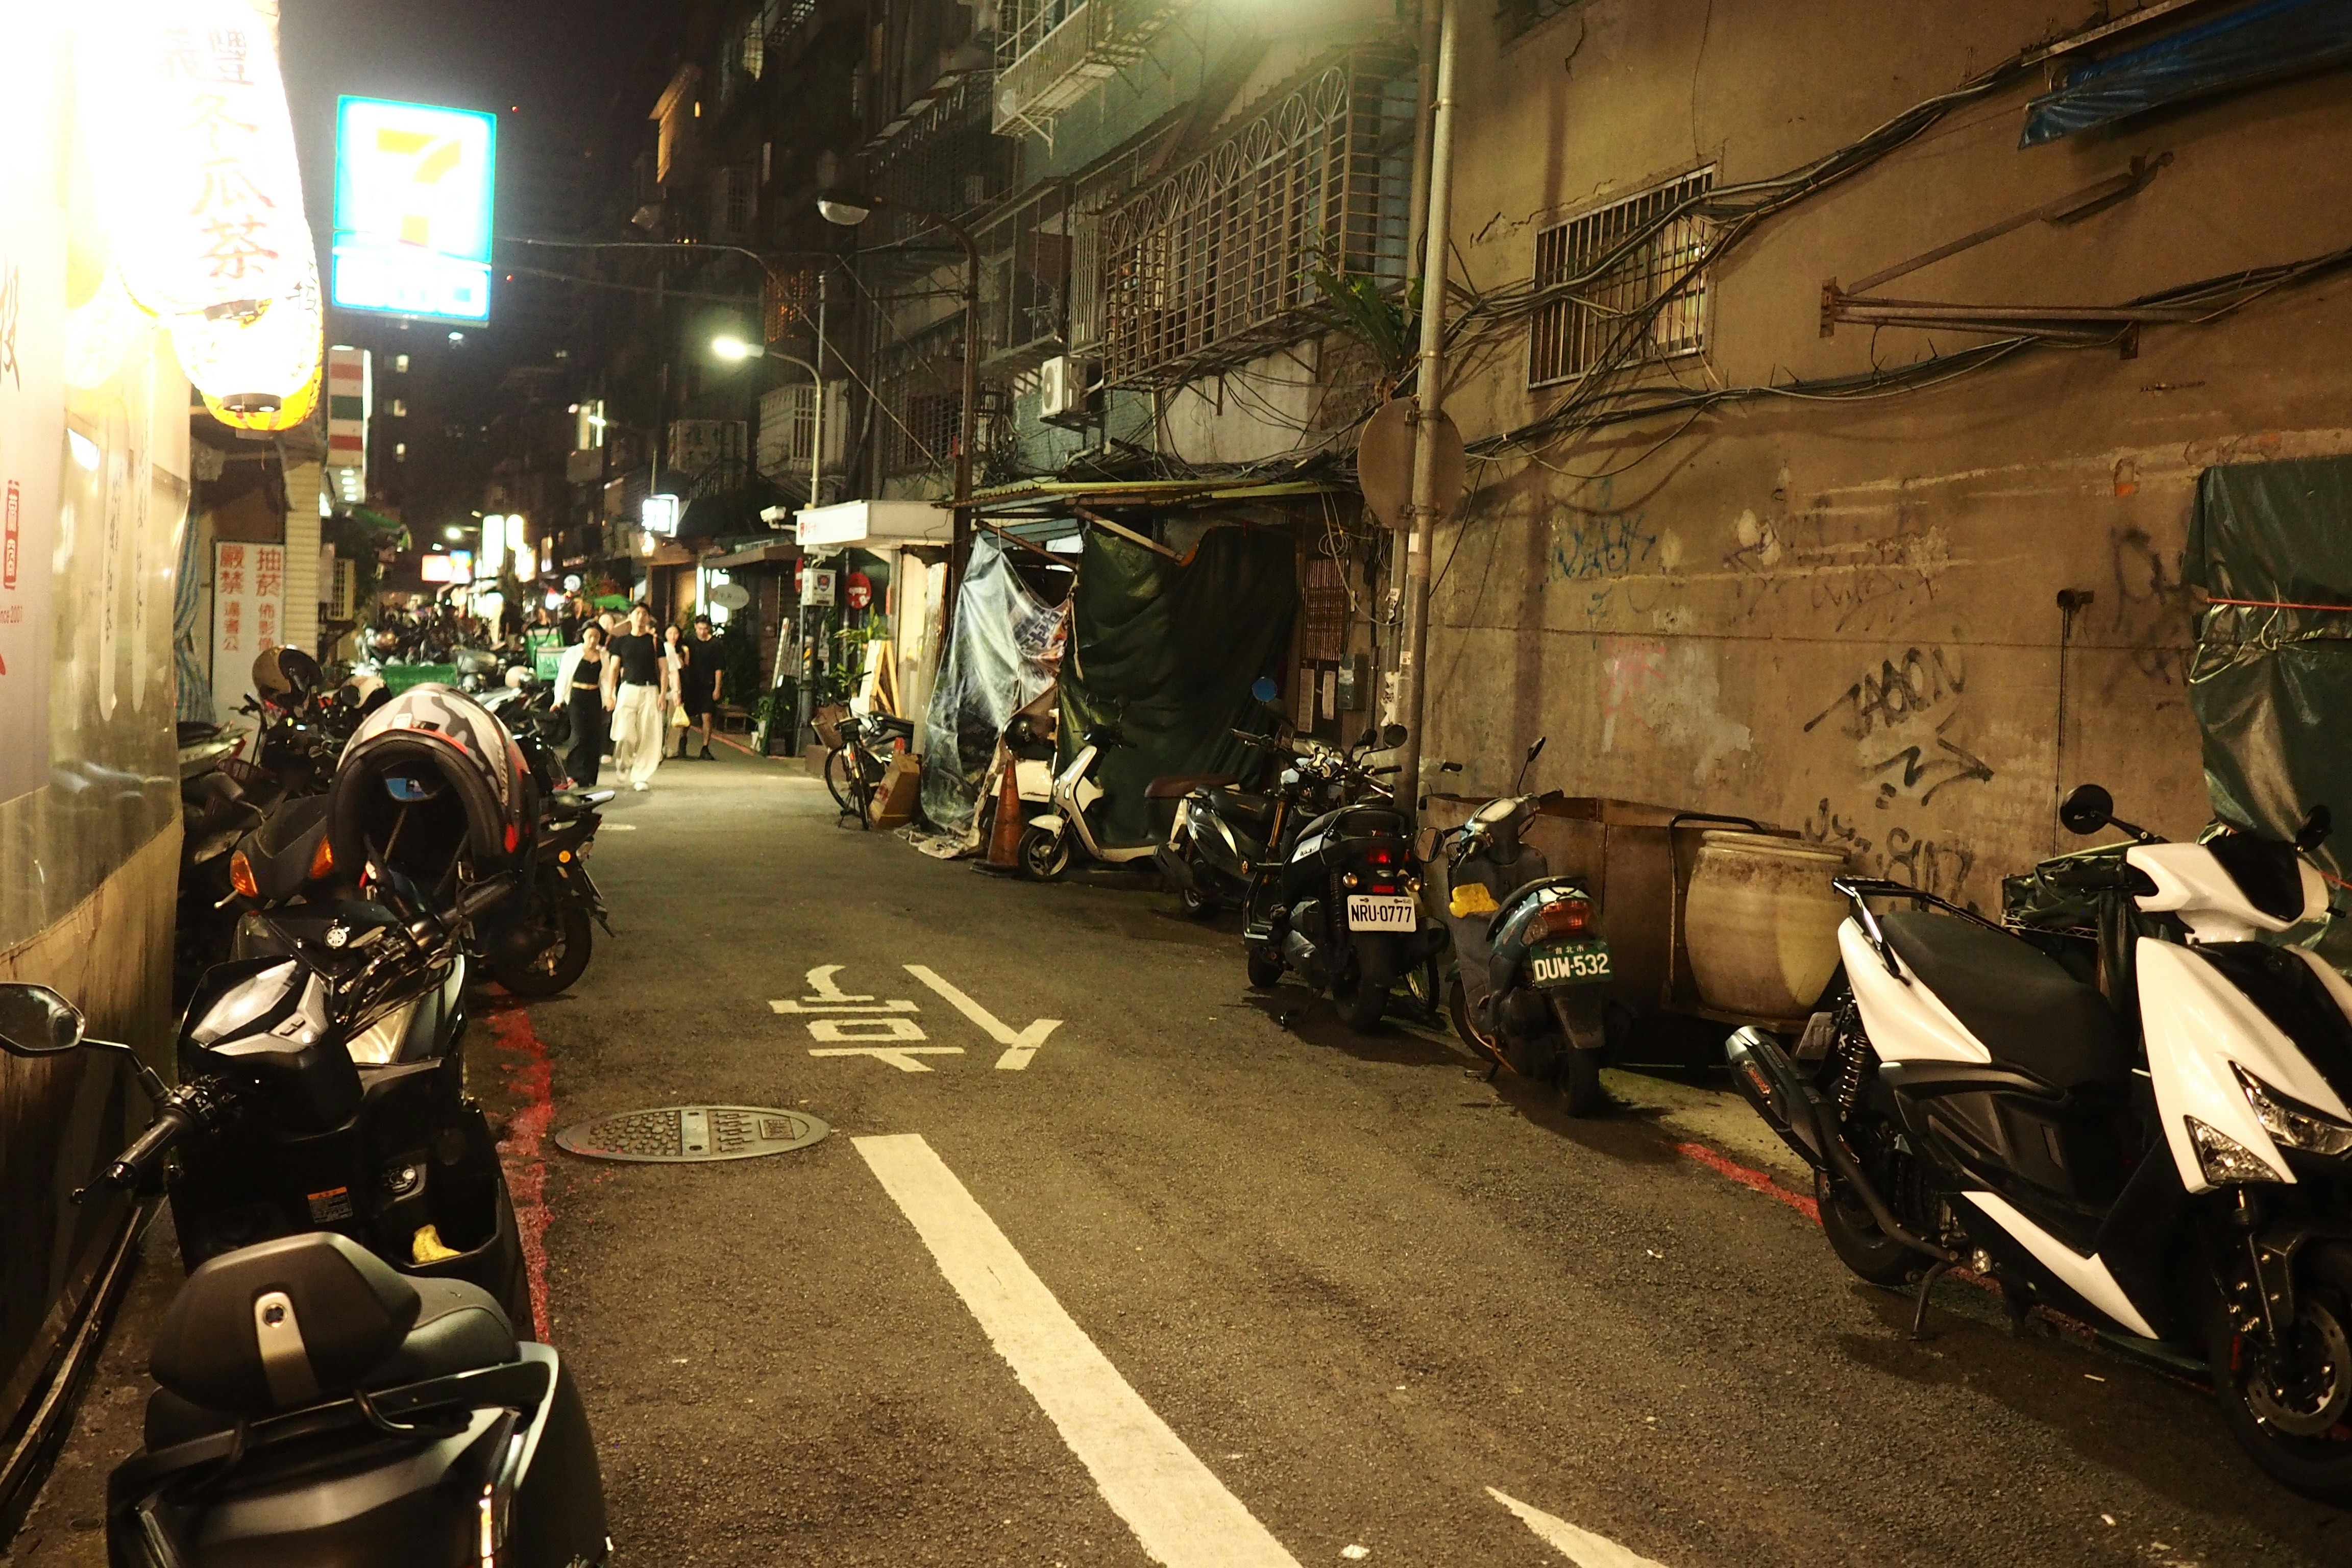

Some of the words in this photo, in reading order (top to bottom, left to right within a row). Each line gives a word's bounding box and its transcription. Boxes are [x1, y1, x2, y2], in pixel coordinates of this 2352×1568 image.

[181, 93, 279, 280] 冬瓜茶
[256, 547, 281, 597] 抽菸
